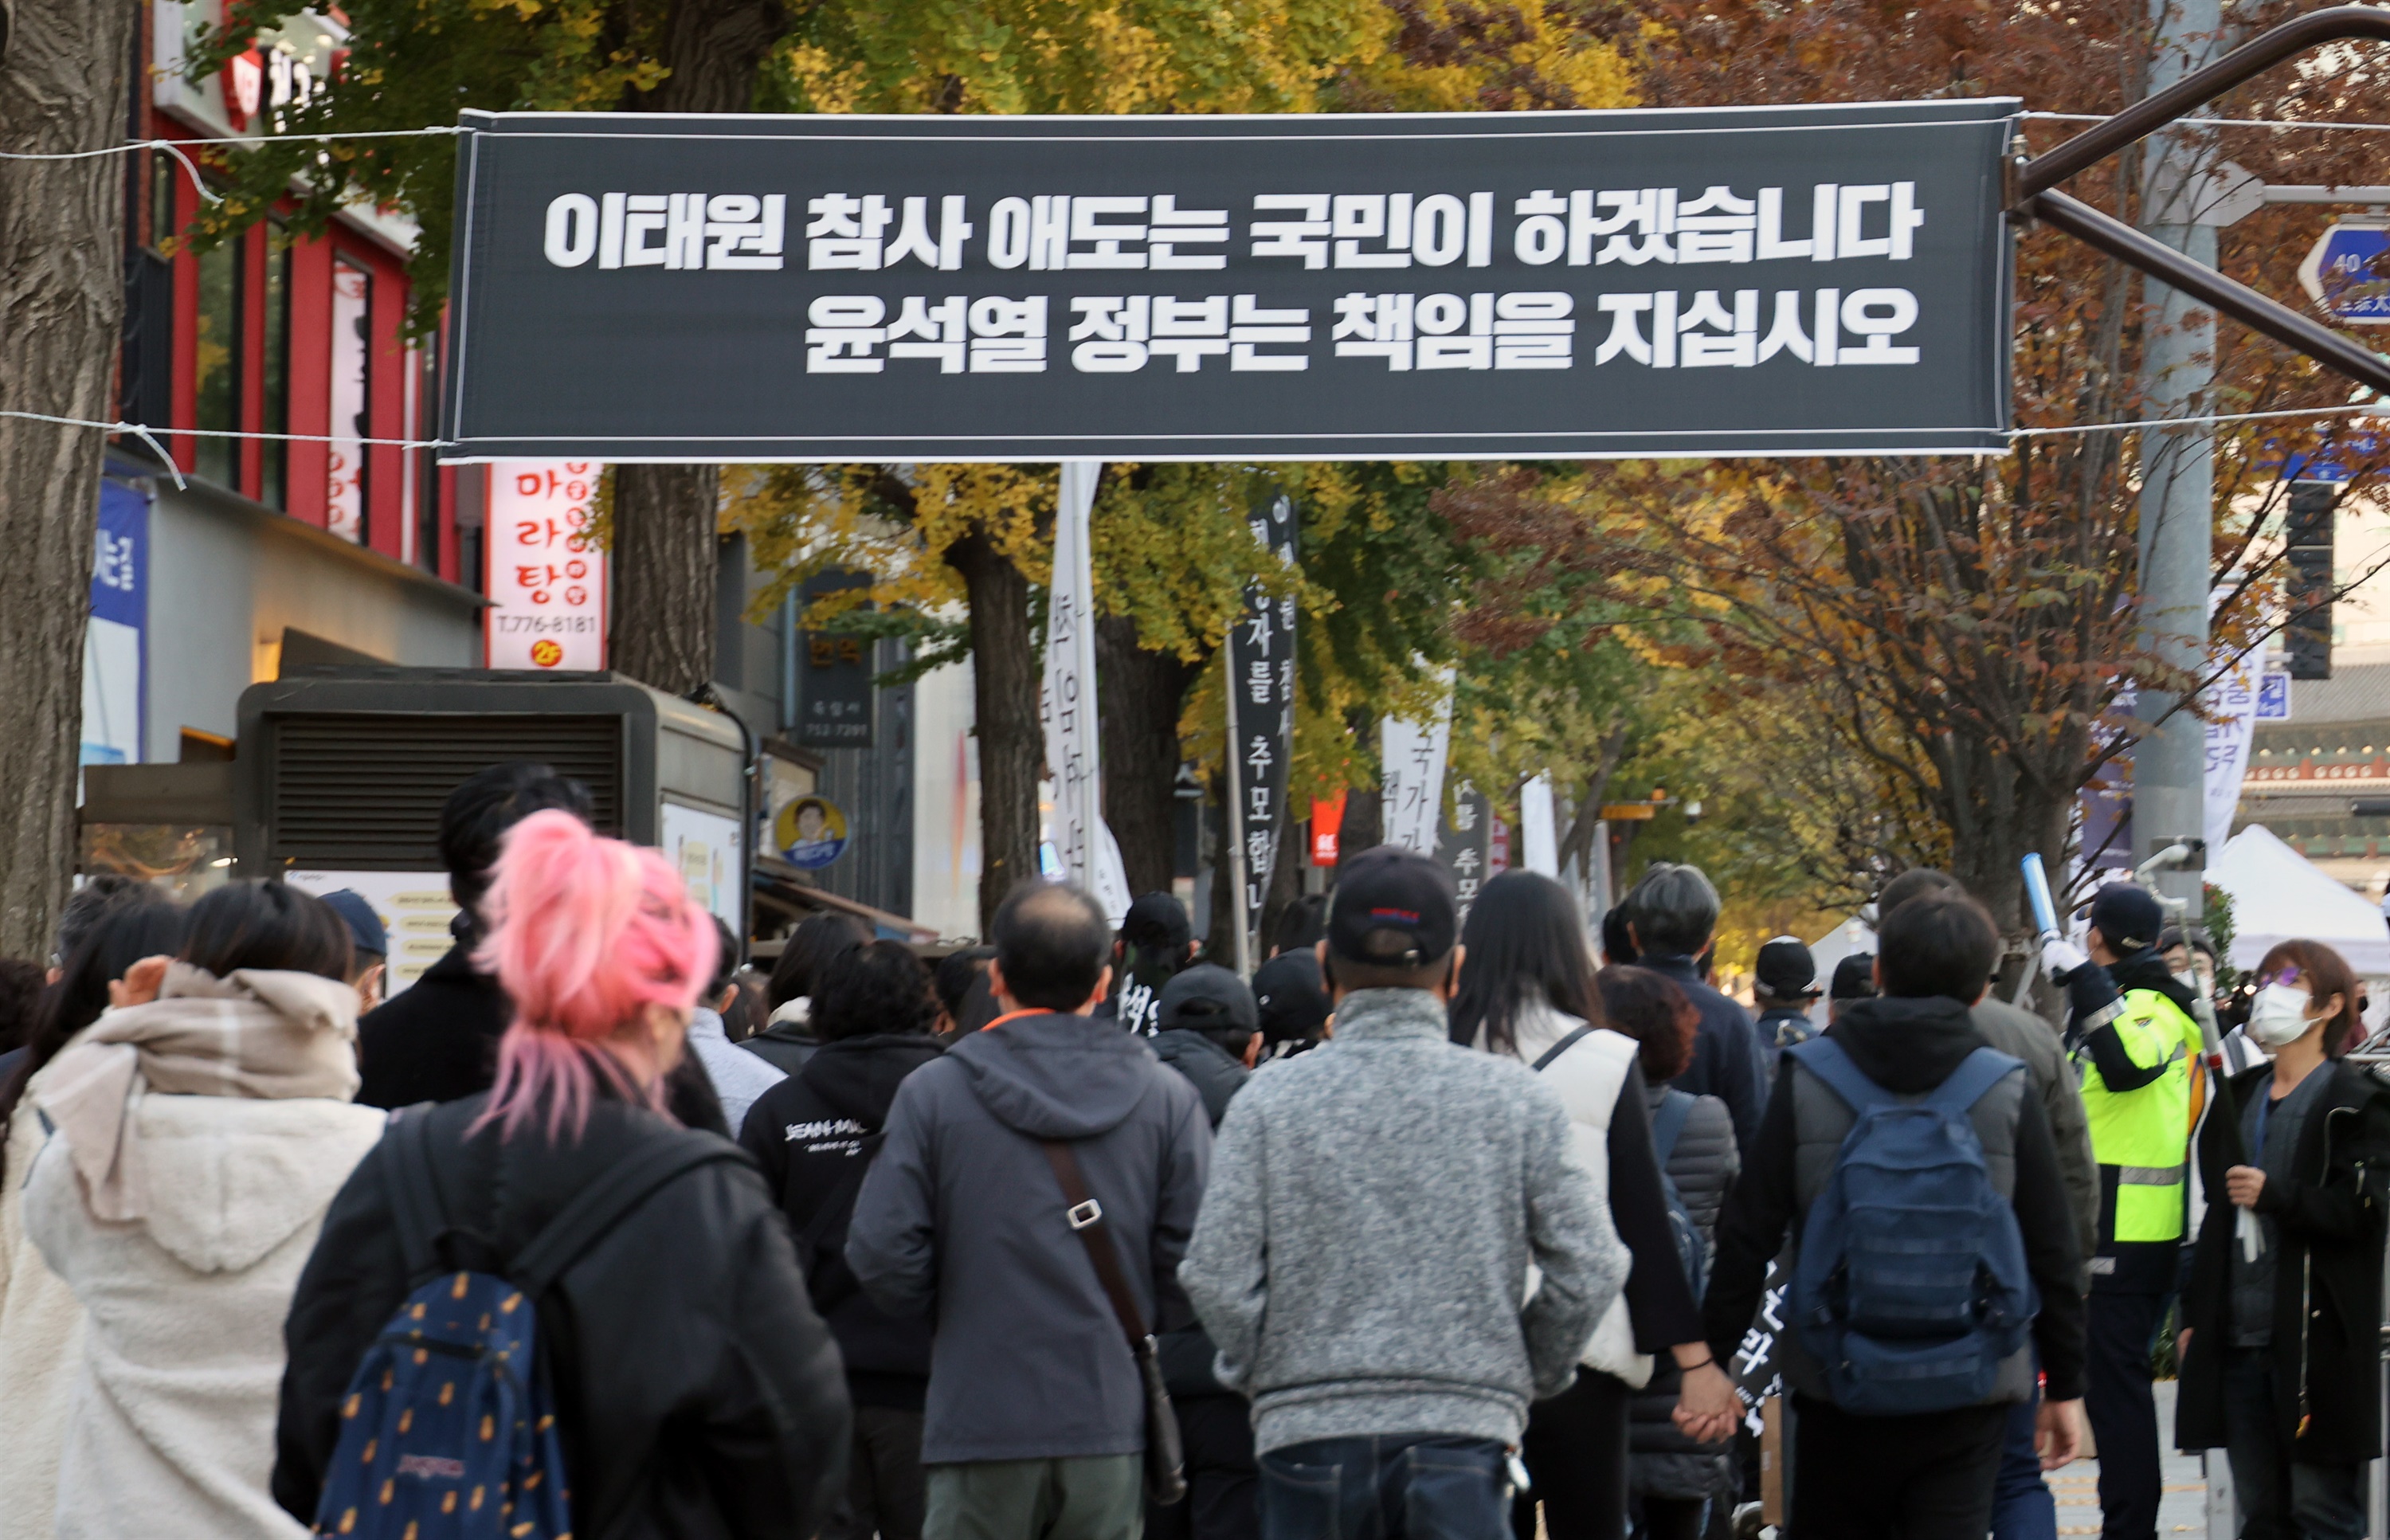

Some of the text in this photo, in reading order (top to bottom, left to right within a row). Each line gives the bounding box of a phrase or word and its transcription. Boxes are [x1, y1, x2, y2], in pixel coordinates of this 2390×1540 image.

[545, 182, 1924, 270] 이태원 참사 애도는 국민이 하겠습니다
[805, 288, 1919, 373] 윤석열 정부는 책임을 지십시오
[515, 470, 562, 604] 마라탕
